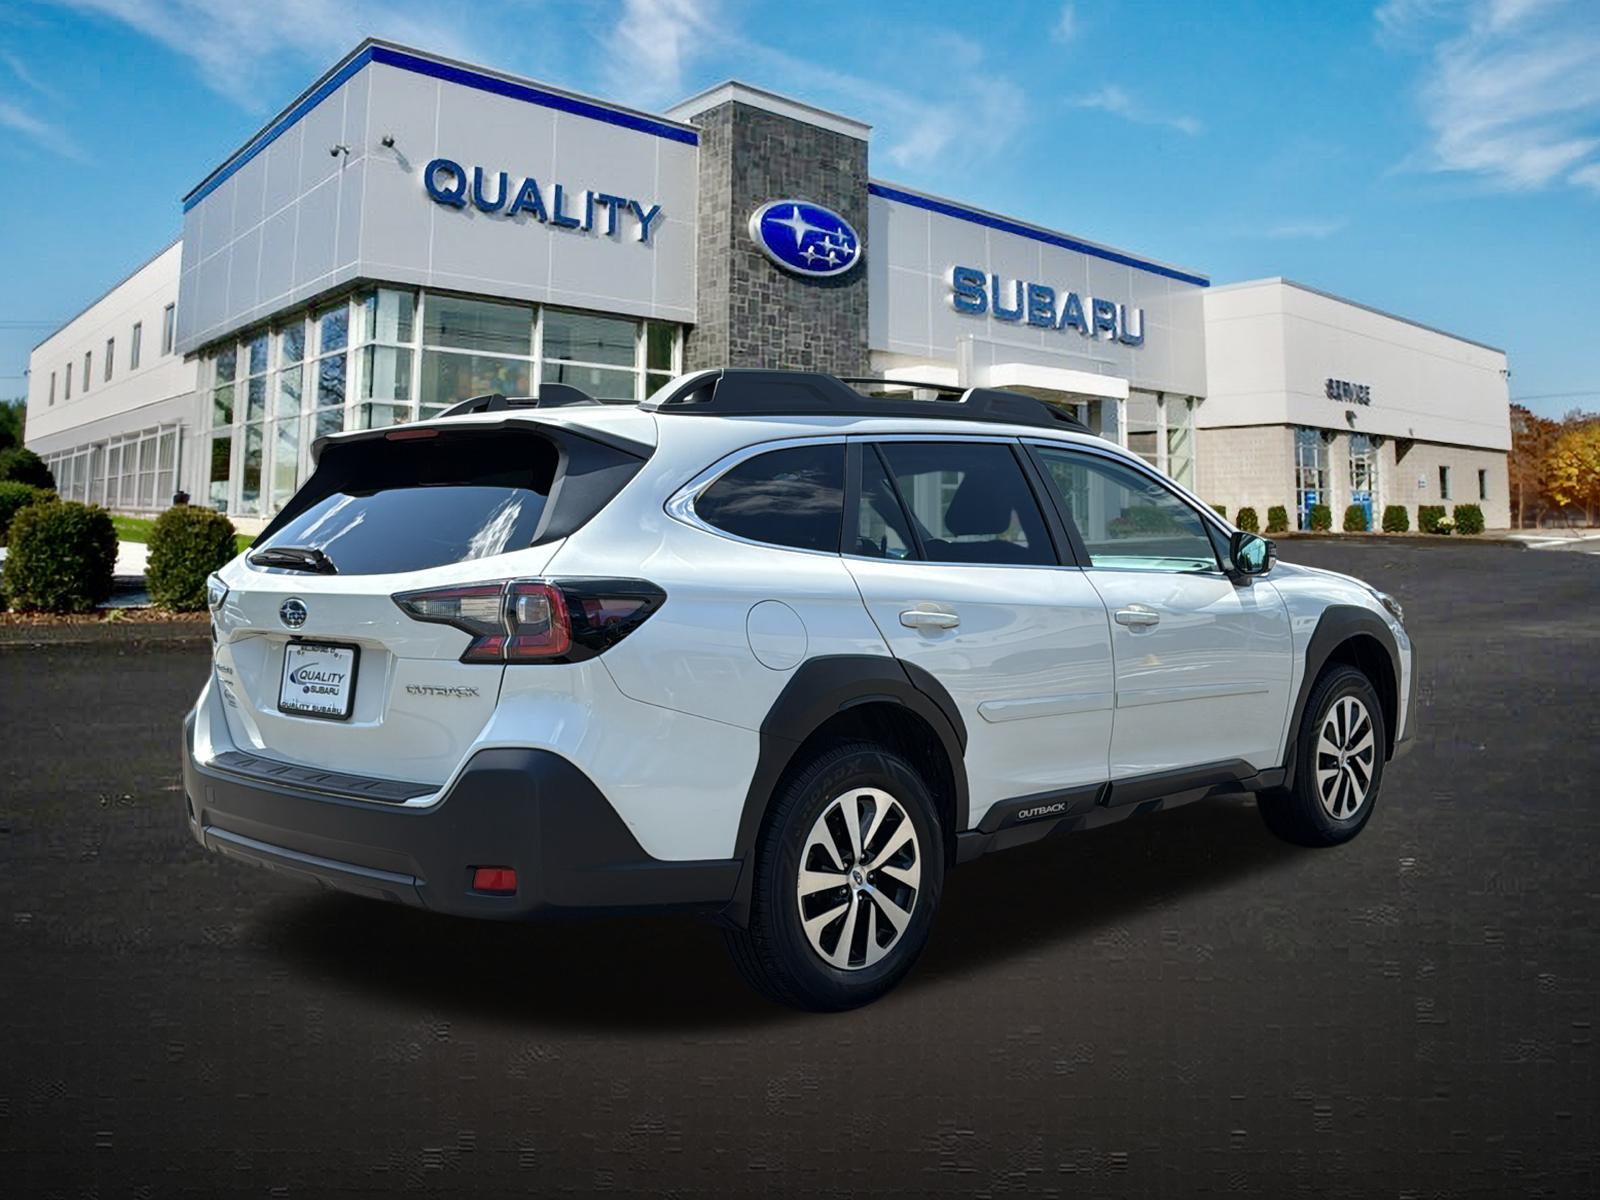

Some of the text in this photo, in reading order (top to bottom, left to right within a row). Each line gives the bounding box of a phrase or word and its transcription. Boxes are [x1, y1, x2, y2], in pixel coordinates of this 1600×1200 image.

[424, 158, 662, 243] QUALITY
[952, 265, 1145, 347] SUBARU
[1325, 378, 1371, 407] SERVICE
[300, 670, 346, 684] QUALITY
[310, 685, 340, 696] SUBARU
[281, 701, 343, 715] QUALITY SUBARU
[1018, 802, 1065, 819] OUTBACK
